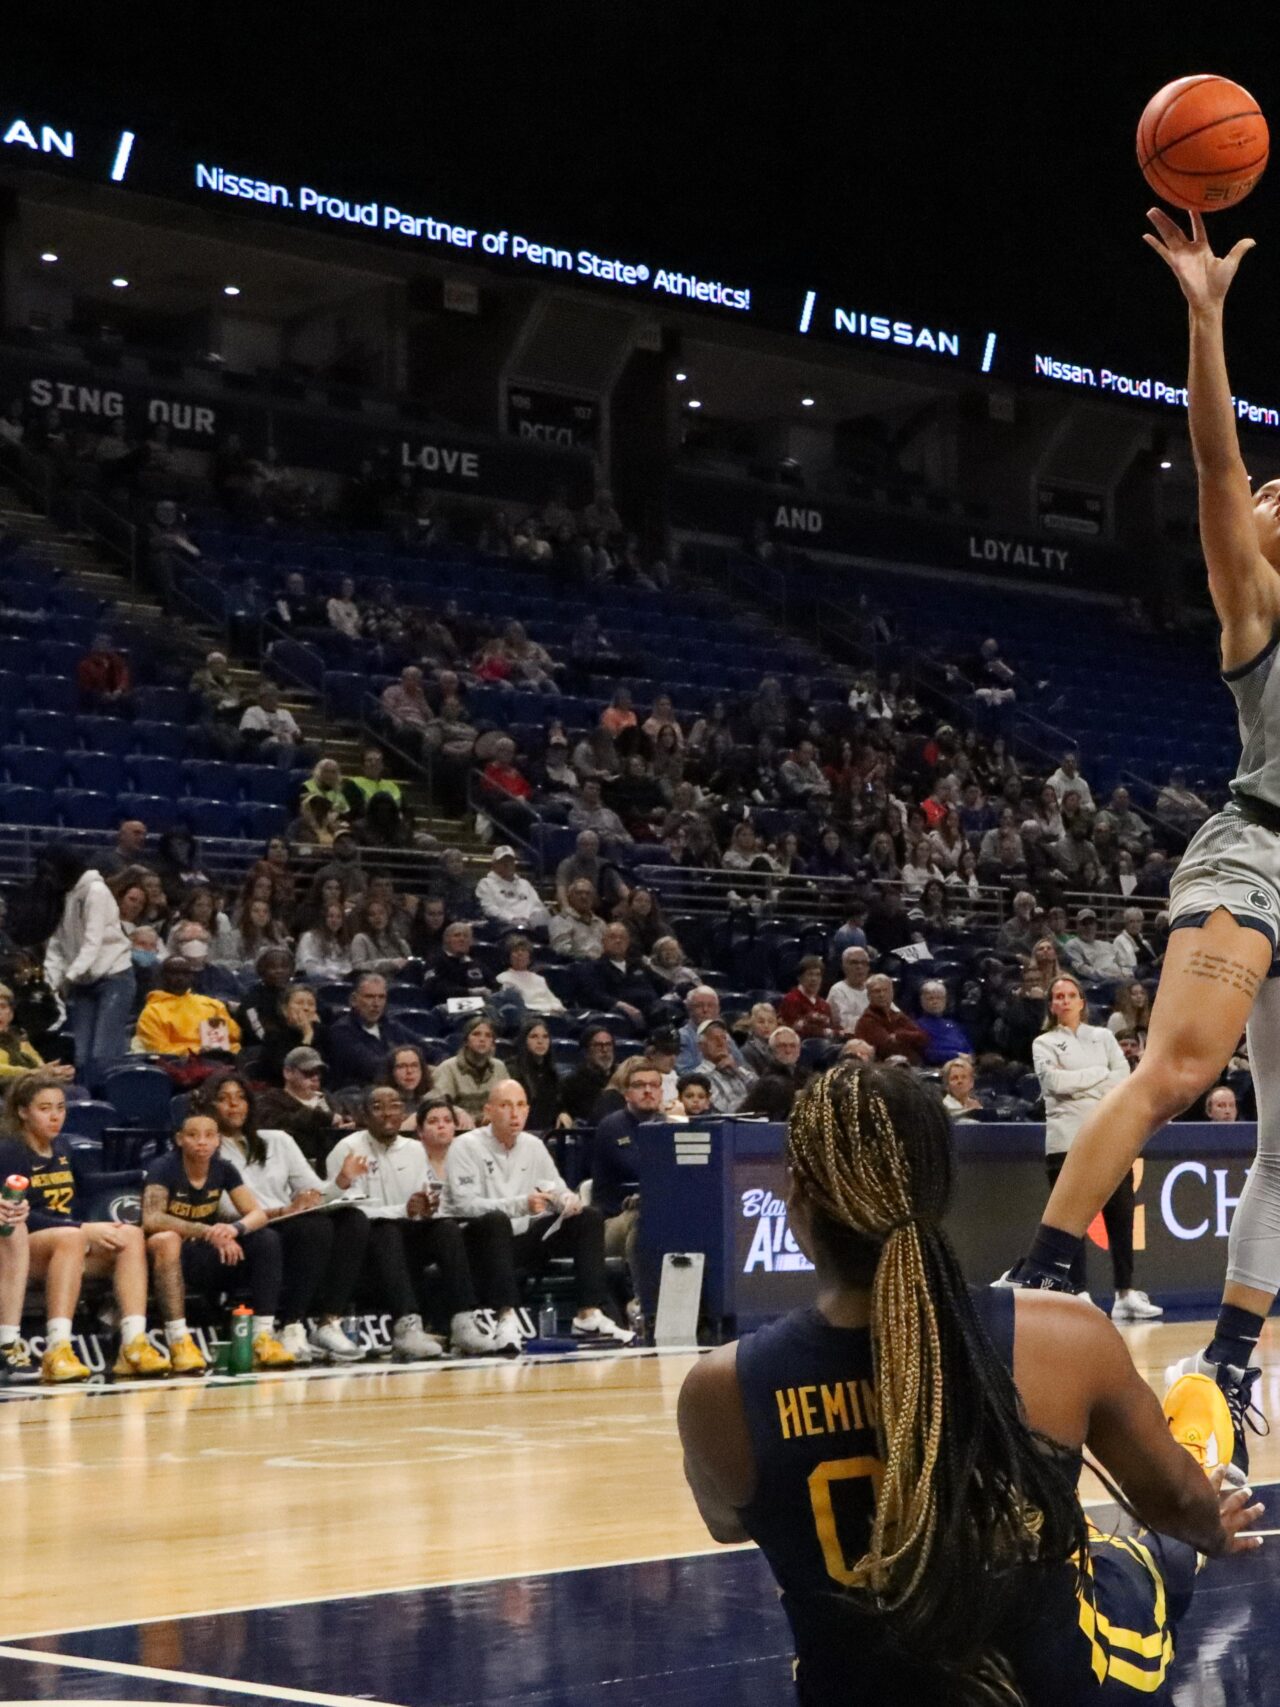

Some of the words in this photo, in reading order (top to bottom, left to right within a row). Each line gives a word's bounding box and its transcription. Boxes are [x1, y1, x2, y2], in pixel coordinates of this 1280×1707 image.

[196, 163, 294, 207] Nissan.
[300, 187, 379, 227] Proud
[383, 205, 478, 248] Partner
[482, 231, 509, 255] of
[512, 236, 573, 270] Penn
[653, 268, 751, 310] Athletics!
[834, 307, 959, 356] NISSAN
[30, 378, 124, 418] SING
[1035, 354, 1097, 387] Nissan.
[1101, 369, 1152, 399] Proud
[1153, 381, 1187, 407] Part
[1237, 399, 1279, 427] Penn
[401, 442, 479, 478] LOVE
[774, 505, 823, 534] AND
[969, 537, 1070, 571] LOYALTY
